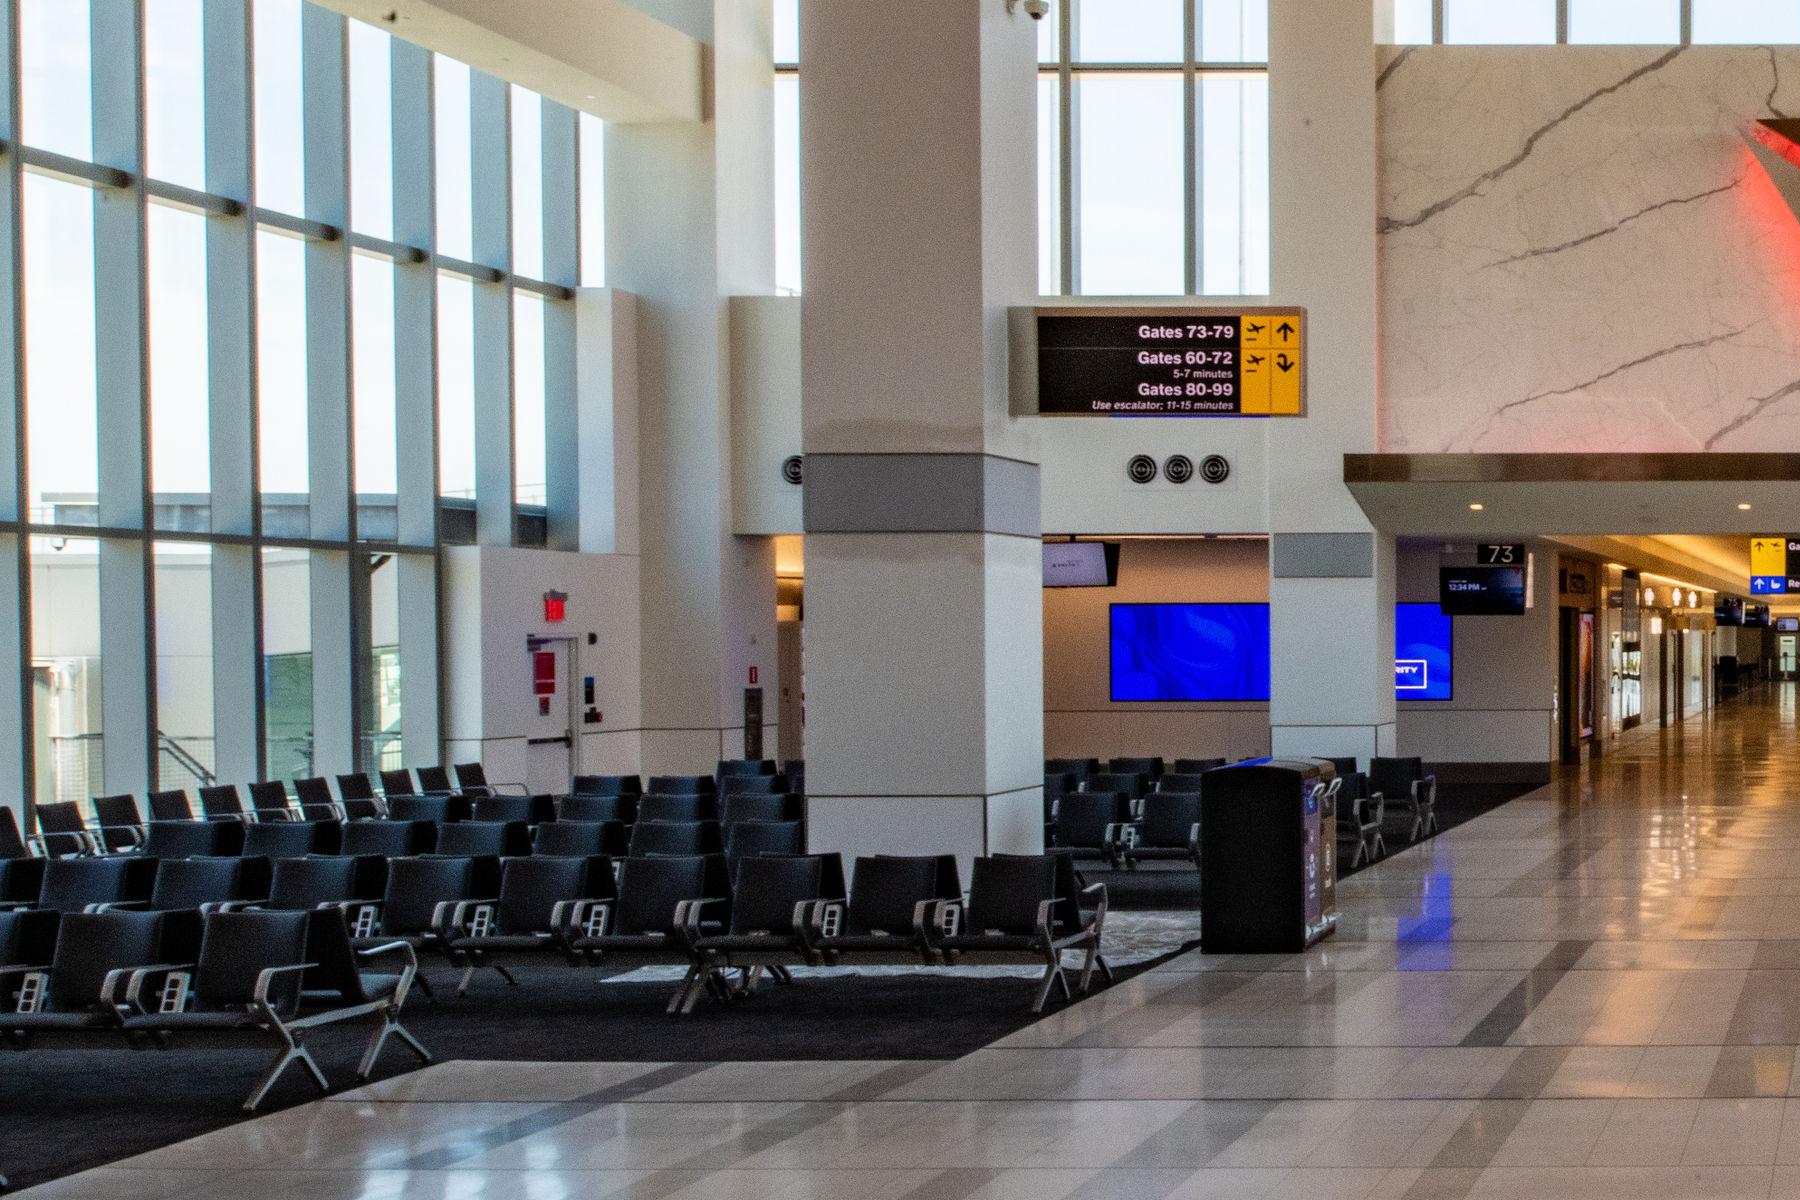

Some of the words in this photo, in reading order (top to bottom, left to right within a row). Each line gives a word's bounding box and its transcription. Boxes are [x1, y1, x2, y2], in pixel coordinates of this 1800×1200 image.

[1138, 325, 1183, 339] Gates
[1186, 325, 1234, 339] 73-79
[1137, 351, 1182, 365] Gates
[1185, 351, 1233, 365] 60-72
[1173, 369, 1190, 379] 5-7
[1192, 369, 1233, 379] minutes
[1137, 382, 1183, 396] Gates
[1185, 382, 1233, 396] 80-99
[1092, 400, 1112, 410] Use
[1113, 400, 1164, 411] escalator;
[1167, 400, 1192, 410] 11-15
[1193, 400, 1234, 410] minutes
[1488, 545, 1514, 563] 73
[1448, 583, 1467, 591] 12:34
[1468, 583, 1480, 591] PM
